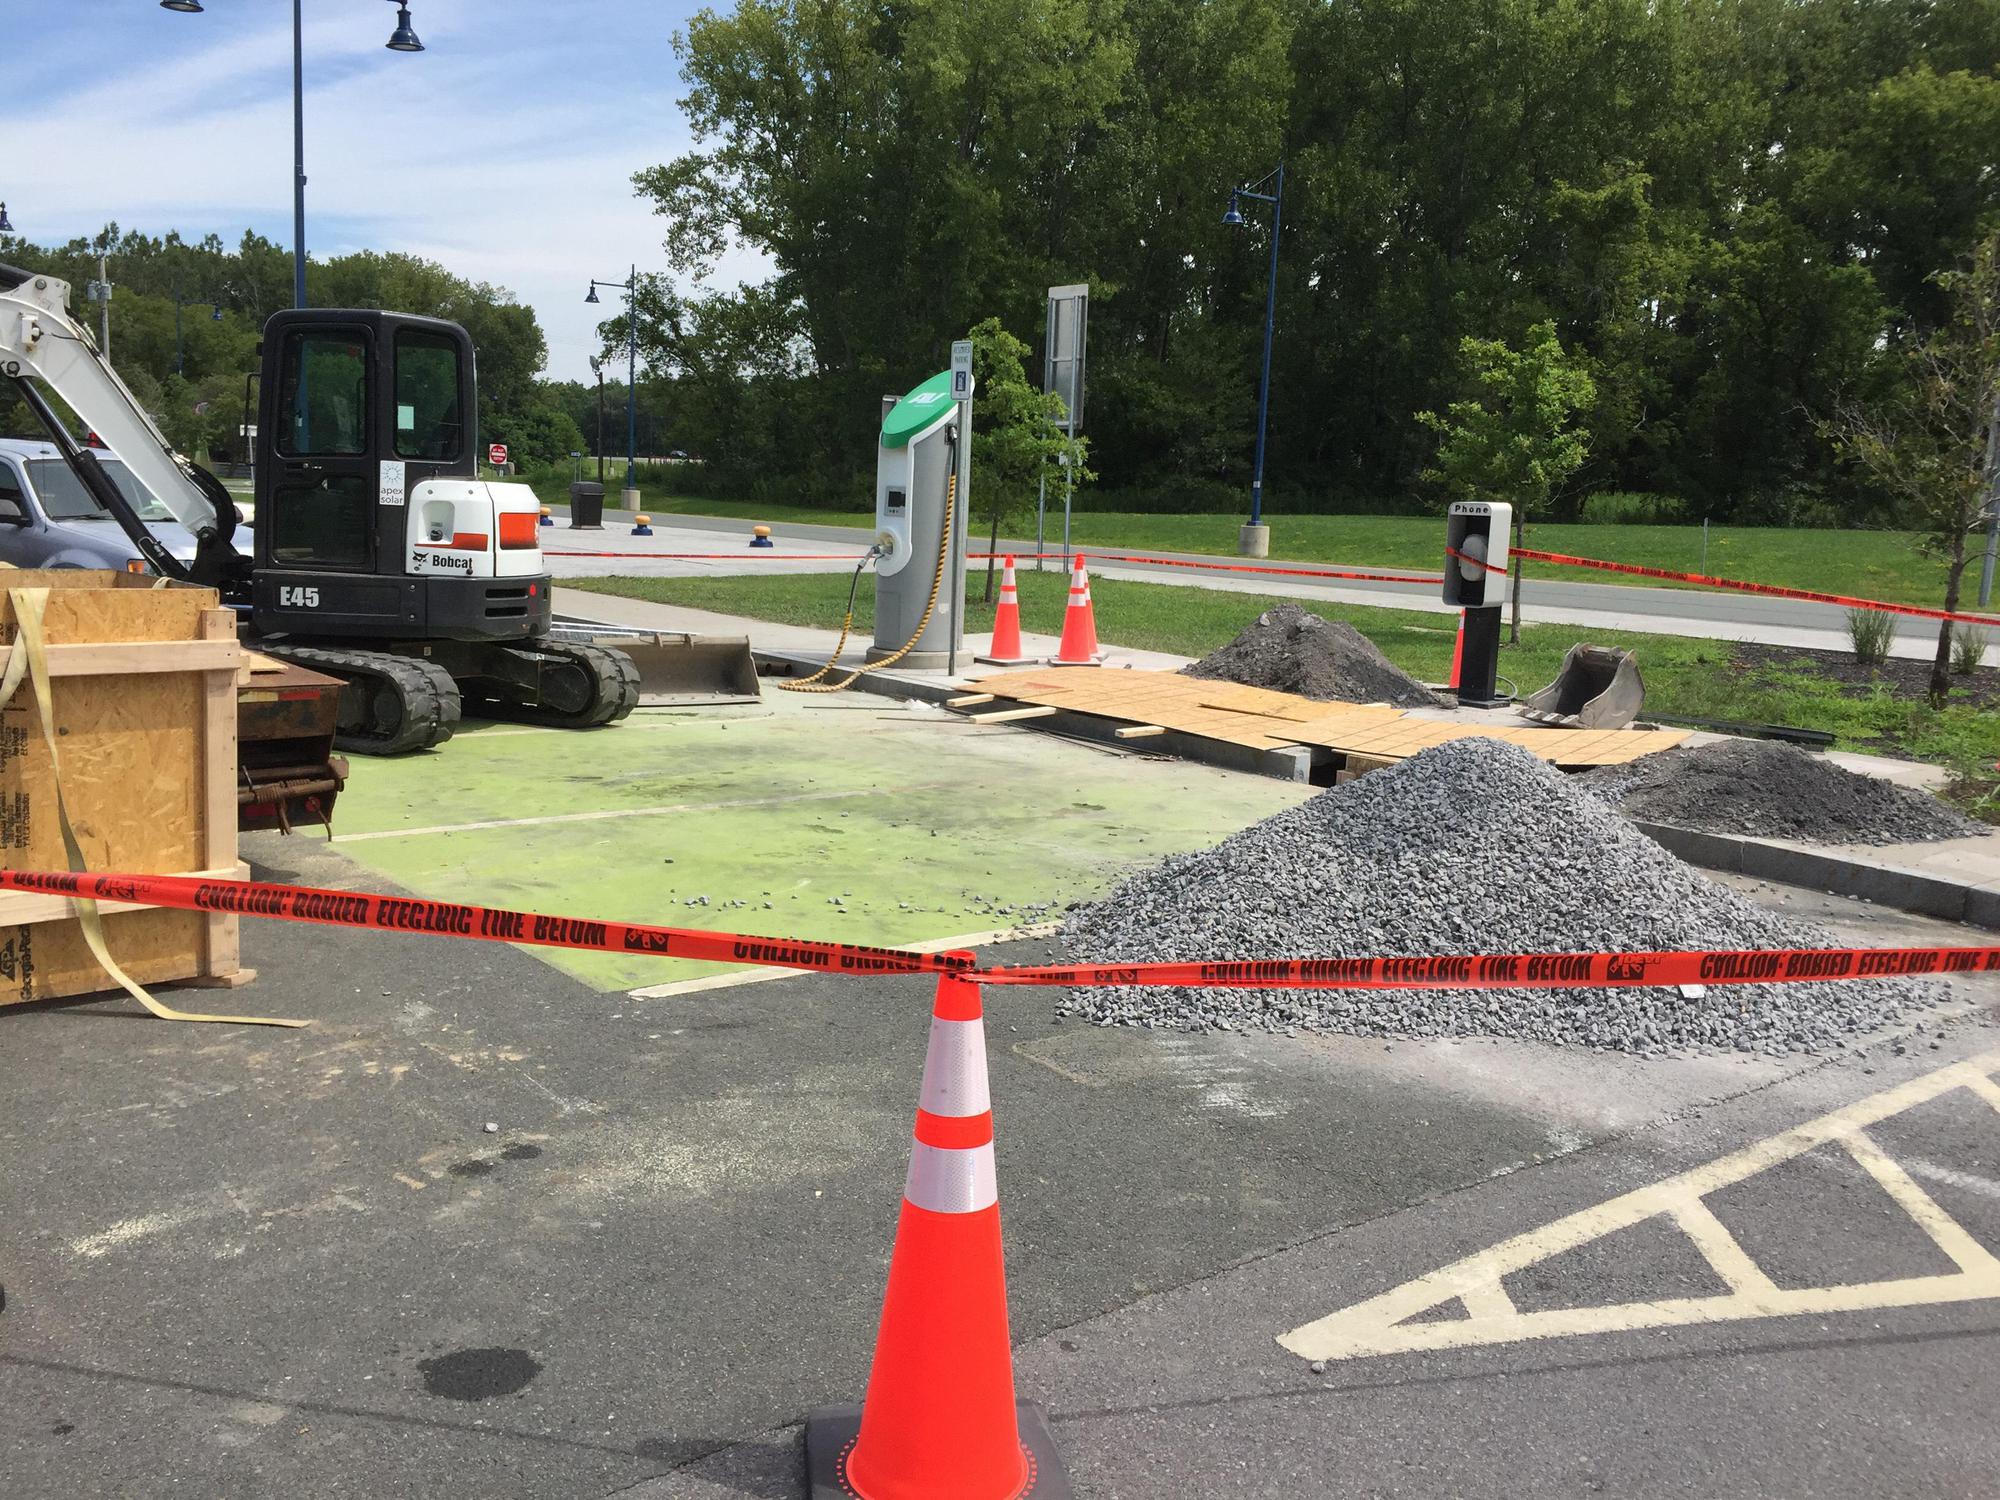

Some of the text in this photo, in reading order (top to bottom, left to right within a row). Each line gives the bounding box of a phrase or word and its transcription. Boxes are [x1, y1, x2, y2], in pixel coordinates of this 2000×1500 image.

[380, 488, 404, 498] apex
[380, 496, 404, 504] solar
[1454, 504, 1489, 513] Phone
[432, 554, 474, 569] Bobcat
[280, 586, 320, 608] E45
